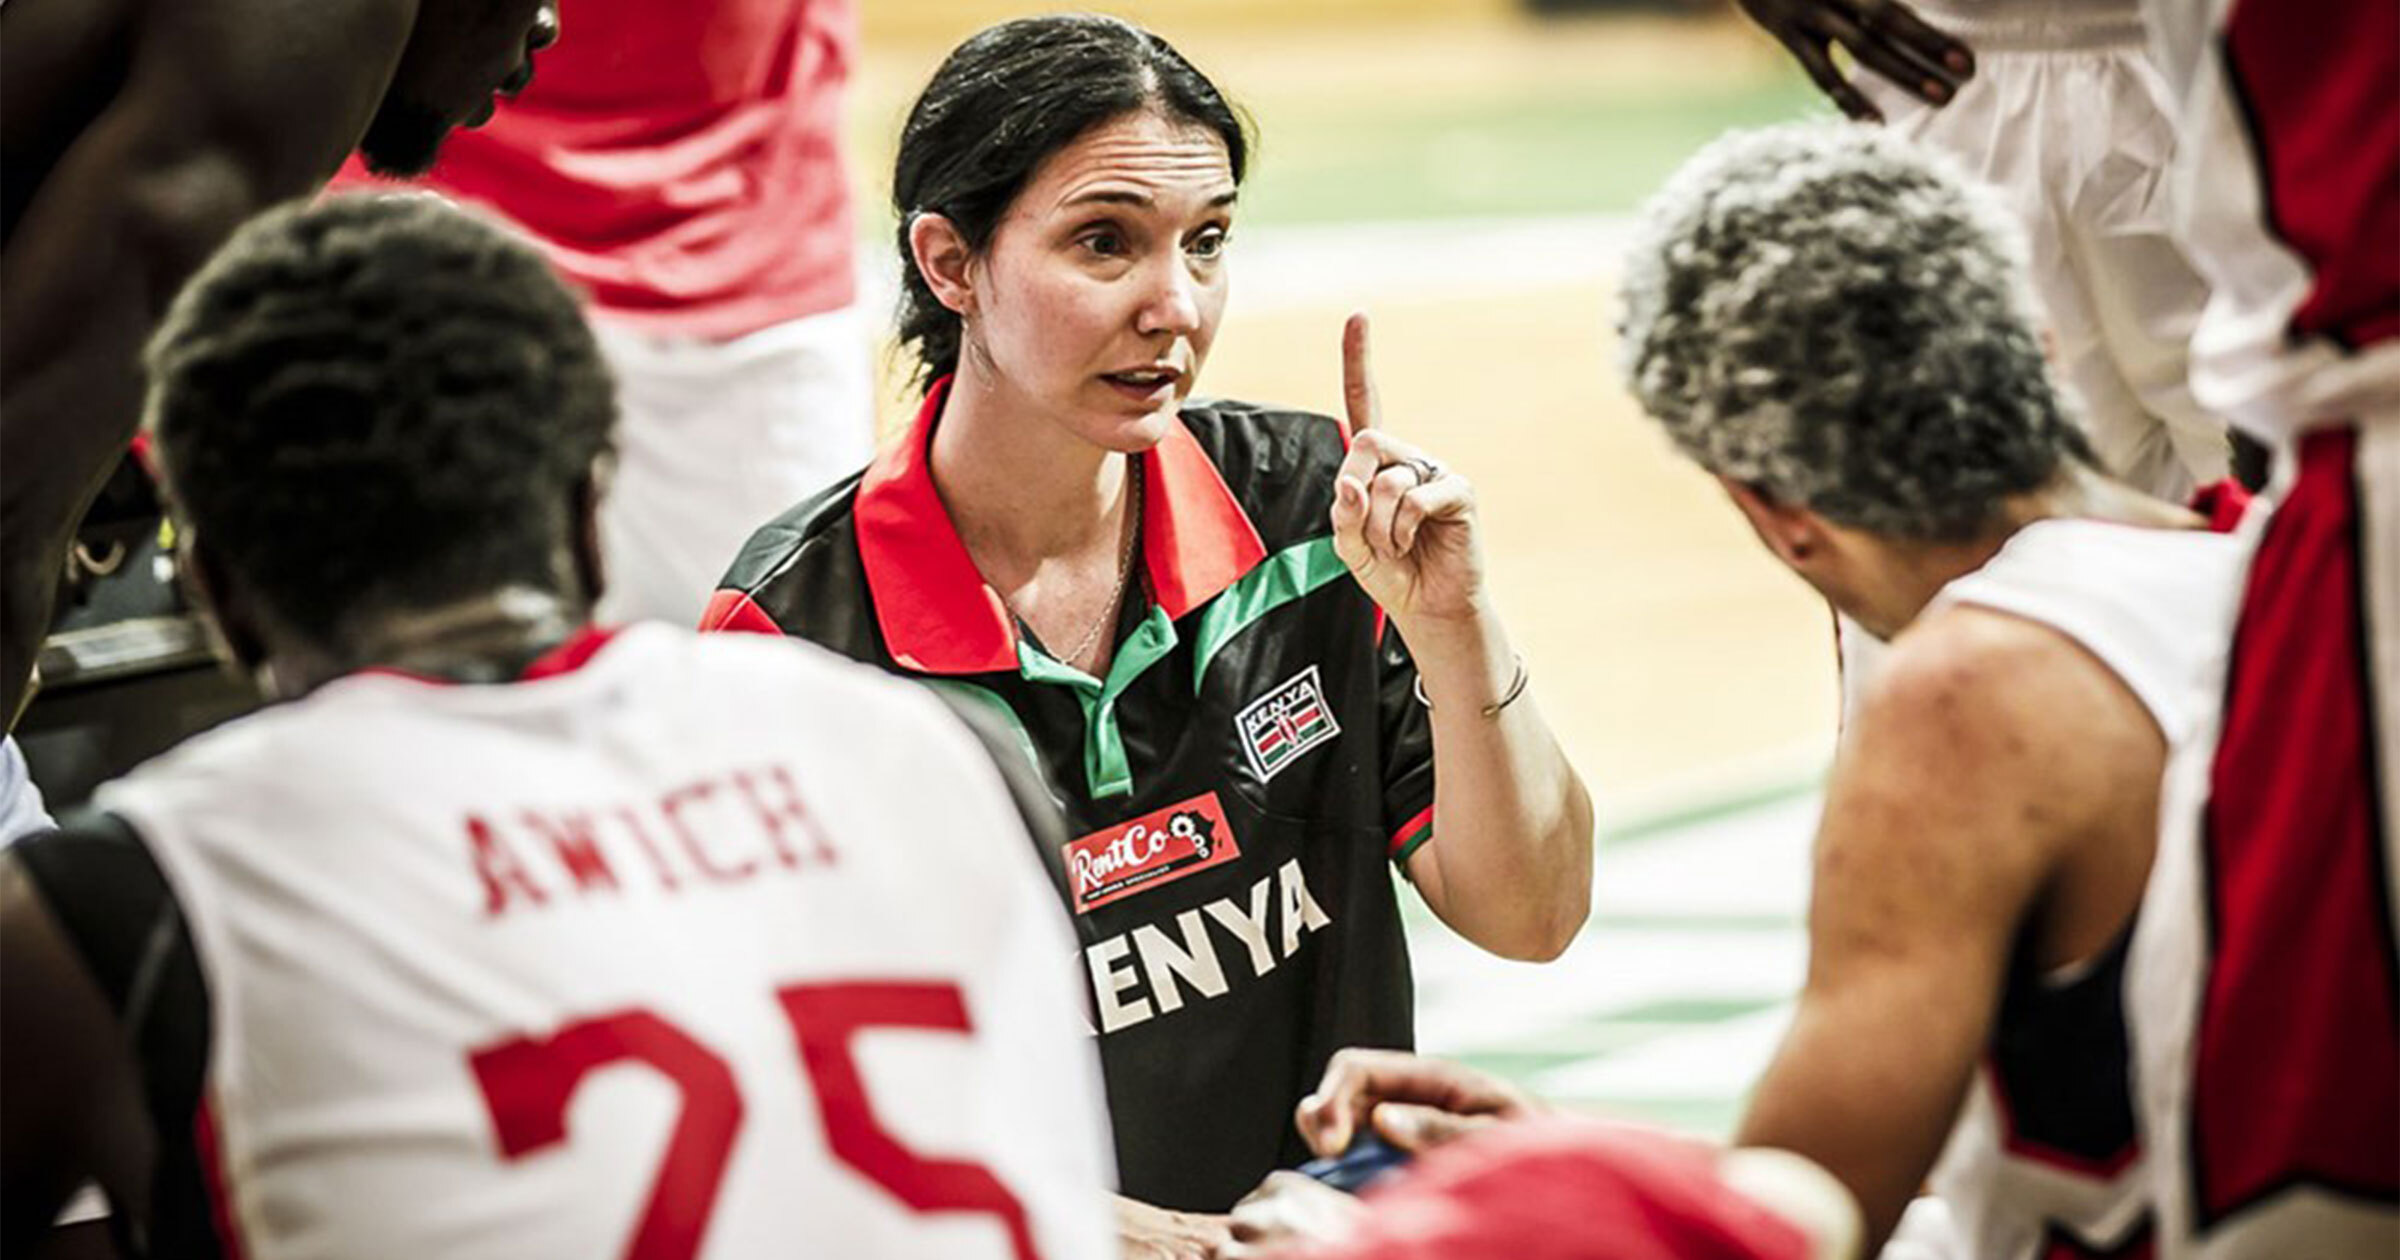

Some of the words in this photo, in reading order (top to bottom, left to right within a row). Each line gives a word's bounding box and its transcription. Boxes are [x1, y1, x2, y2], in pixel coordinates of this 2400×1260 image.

[1245, 681, 1315, 731] KENYA
[465, 766, 837, 916] AWICH
[1072, 825, 1170, 893] RentCo
[1079, 859, 1331, 1033] ENYA
[466, 978, 1044, 1260] 25
